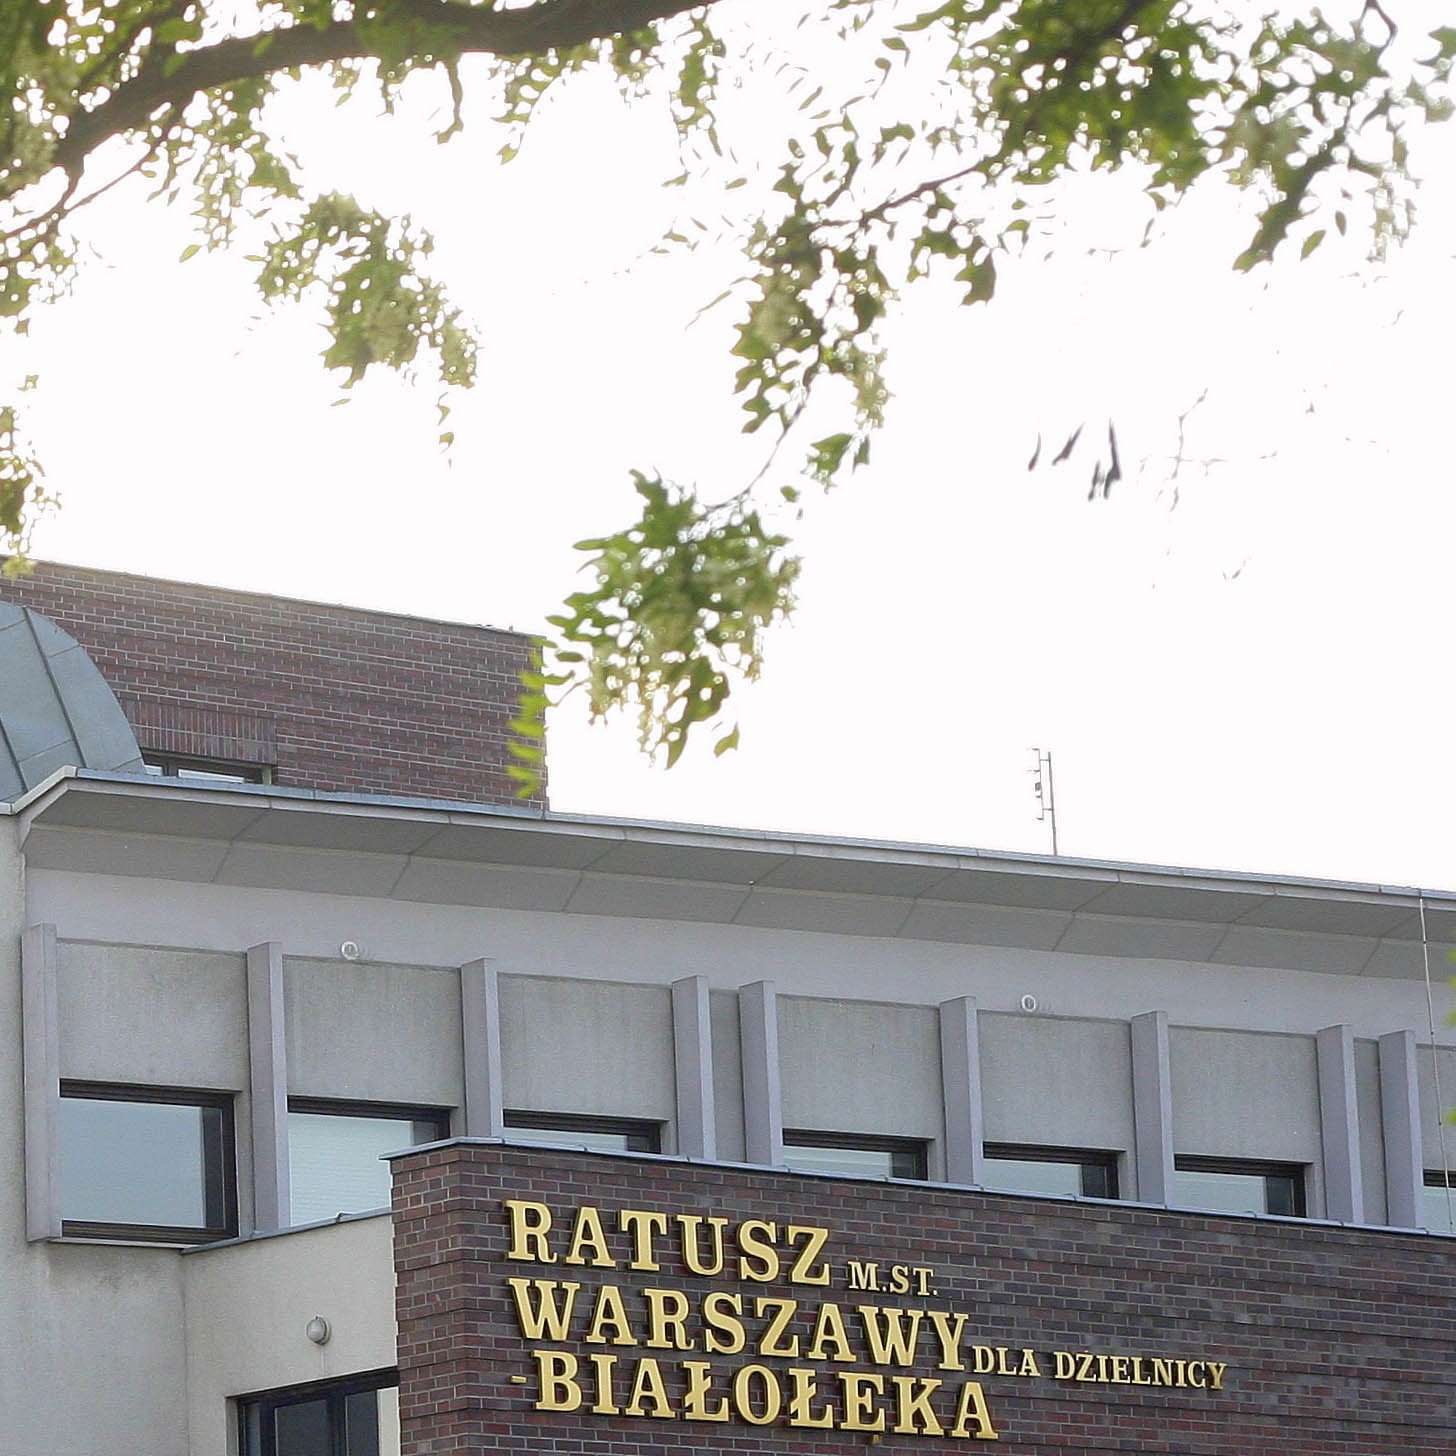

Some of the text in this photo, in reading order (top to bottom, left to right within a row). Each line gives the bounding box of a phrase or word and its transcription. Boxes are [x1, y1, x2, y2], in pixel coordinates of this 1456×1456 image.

[504, 1199, 939, 1297] RATUSZ M.ST.
[506, 1277, 1228, 1390] WARSZAWY DLA DZIELNICY
